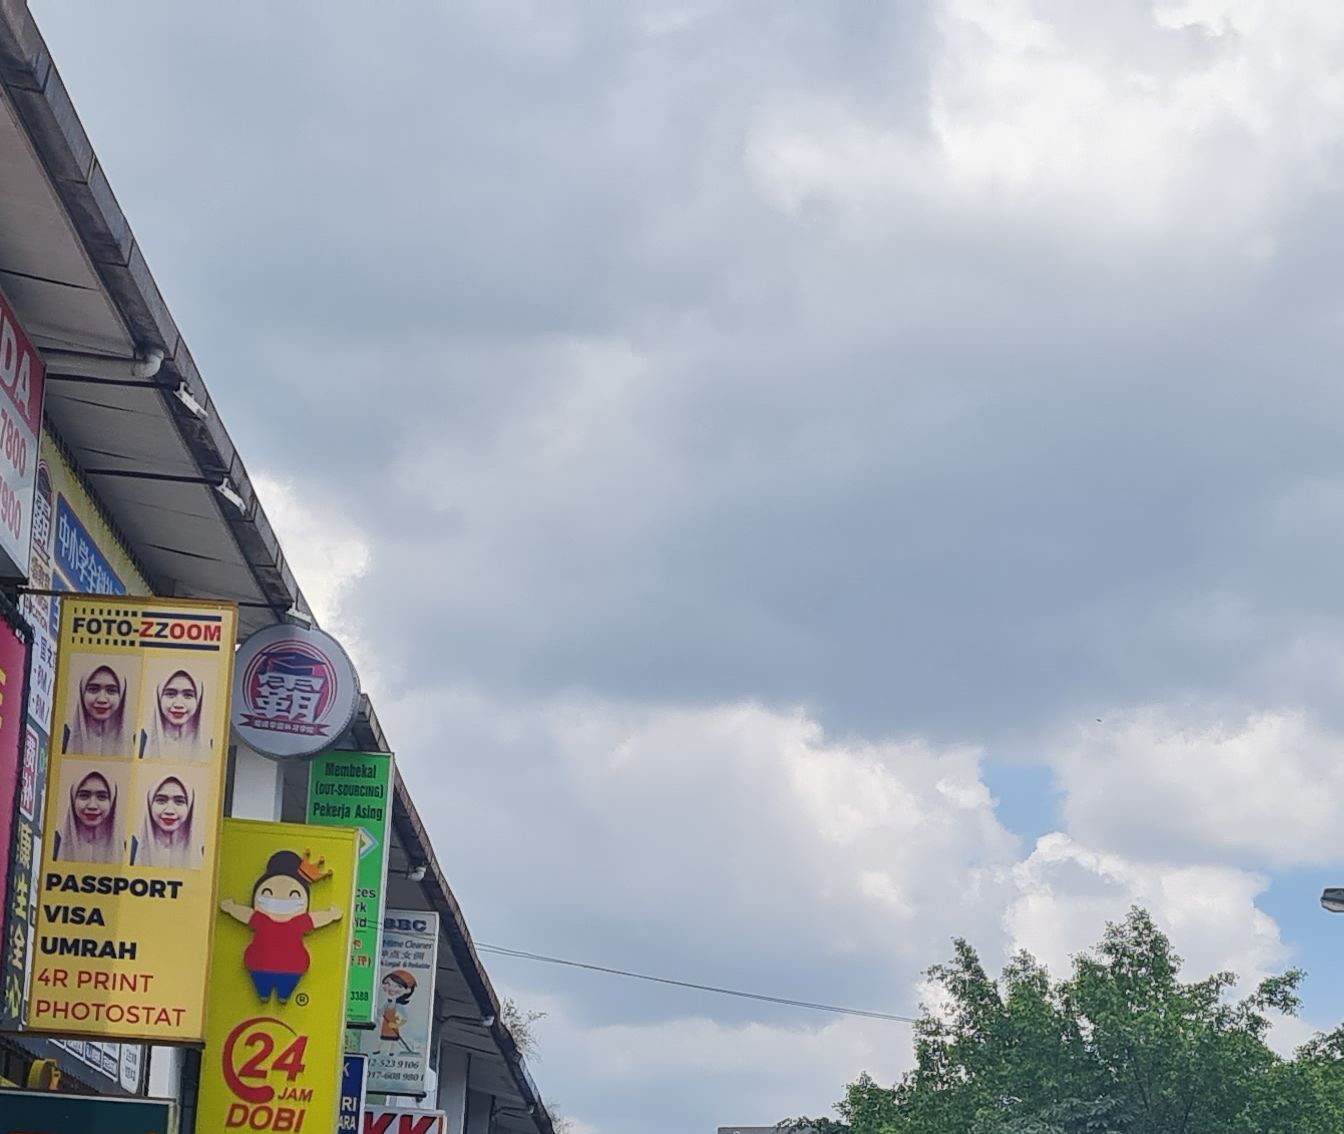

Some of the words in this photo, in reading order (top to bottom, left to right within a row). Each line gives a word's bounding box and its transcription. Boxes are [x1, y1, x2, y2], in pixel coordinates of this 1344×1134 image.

[0, 408, 26, 478] 7800
[72, 617, 222, 642] FOTO-ZZOOM
[325, 762, 377, 778] Membekal
[313, 802, 350, 819] Pekerja
[355, 805, 383, 821] Asing
[45, 873, 183, 899] PASSPORT
[43, 905, 105, 926] VISA
[41, 937, 137, 960] UMRAH
[37, 968, 68, 988] 4R
[77, 971, 154, 993] PRINT
[36, 1000, 186, 1027] PHOTOSTAT
[238, 1032, 308, 1082] 24
[278, 1088, 313, 1102] JAM
[225, 1103, 306, 1133] DOBI
